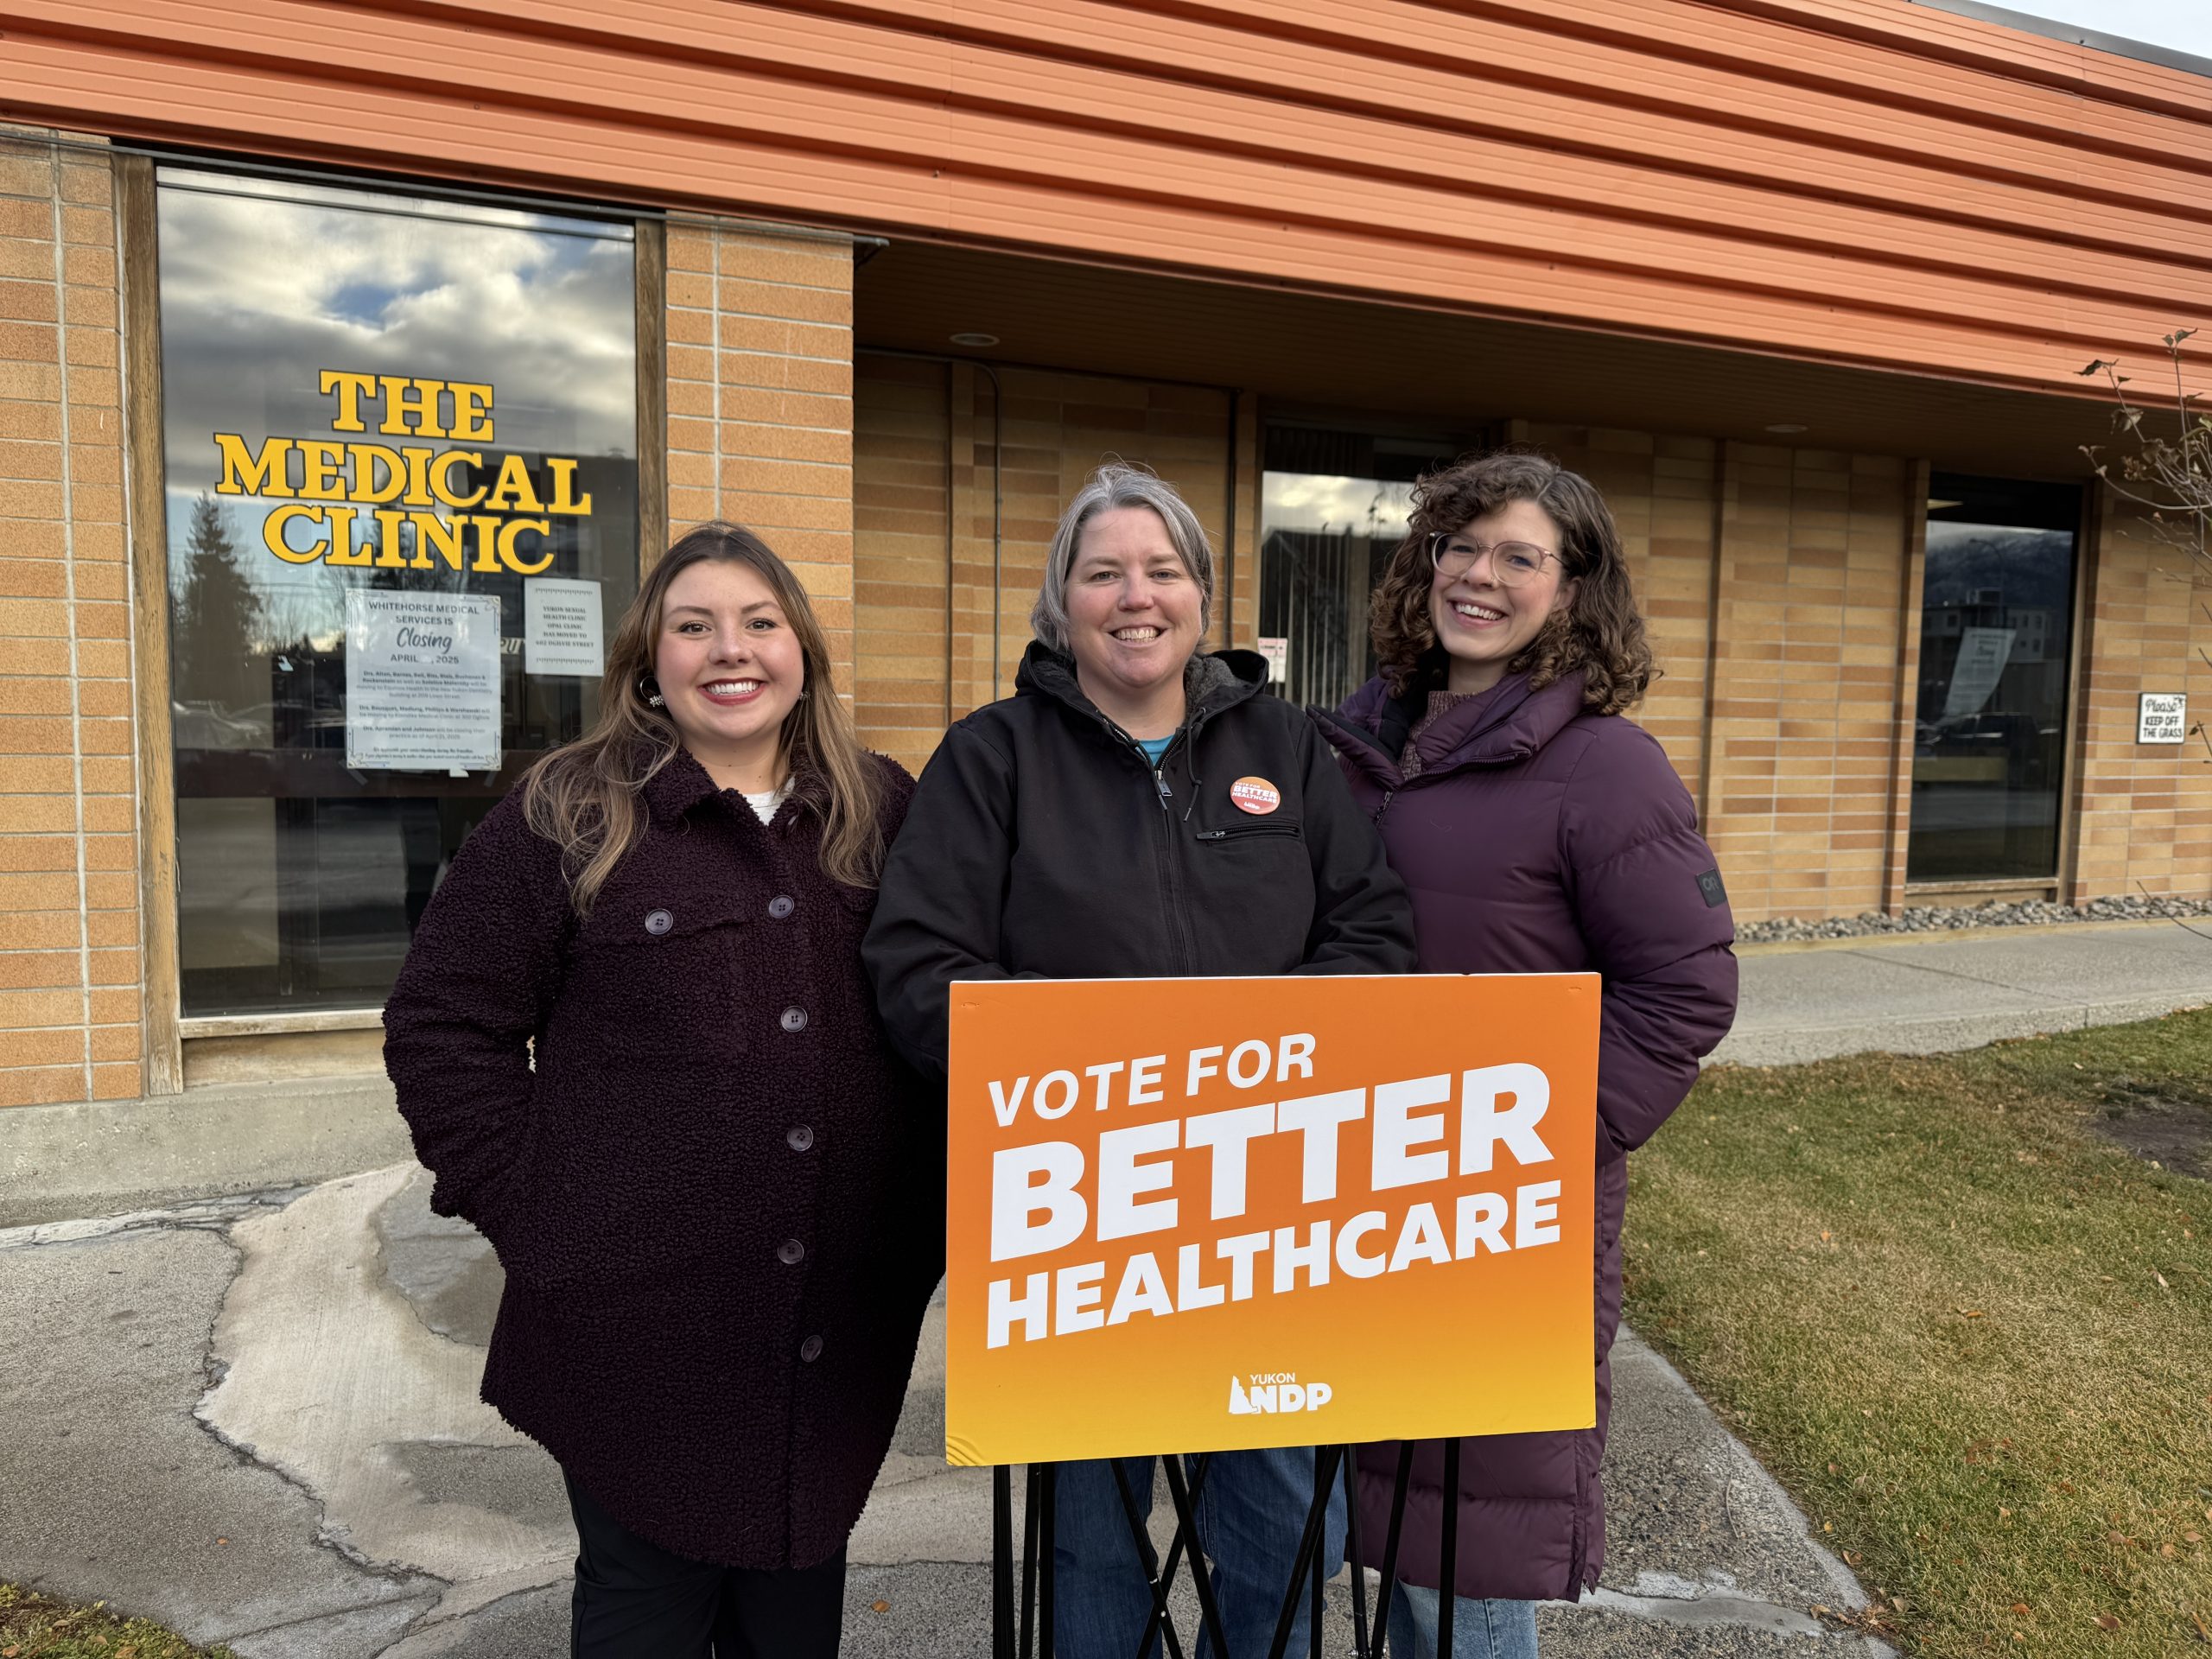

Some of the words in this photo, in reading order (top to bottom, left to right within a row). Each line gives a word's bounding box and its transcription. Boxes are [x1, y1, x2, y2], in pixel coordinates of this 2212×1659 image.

[319, 369, 494, 442] THE
[213, 432, 592, 516] MEDICAL
[263, 503, 555, 575] CLINIC
[369, 601, 434, 612] WHITEHORSE
[436, 604, 480, 614] MEDICAL
[396, 615, 442, 625] SERVICES
[445, 617, 454, 626] IS
[397, 626, 453, 655] Closing
[391, 654, 419, 663] APRIL
[436, 655, 459, 664] 2025
[2145, 698, 2177, 713] Please
[2145, 716, 2164, 726] KEEP
[2165, 716, 2180, 726] OFF
[2143, 728, 2158, 738] THE
[2159, 728, 2183, 738] GRASS
[1232, 792, 1277, 804] HEALTHCARE
[1233, 785, 1278, 799] BETTER
[988, 1053, 1166, 1127] VOTE
[1185, 1033, 1316, 1096] FOR
[990, 1062, 1555, 1262] BETTER
[987, 1179, 1561, 1350] HEALTHCARE
[1250, 1372, 1296, 1384] YUKON
[1250, 1382, 1332, 1414] NDP
